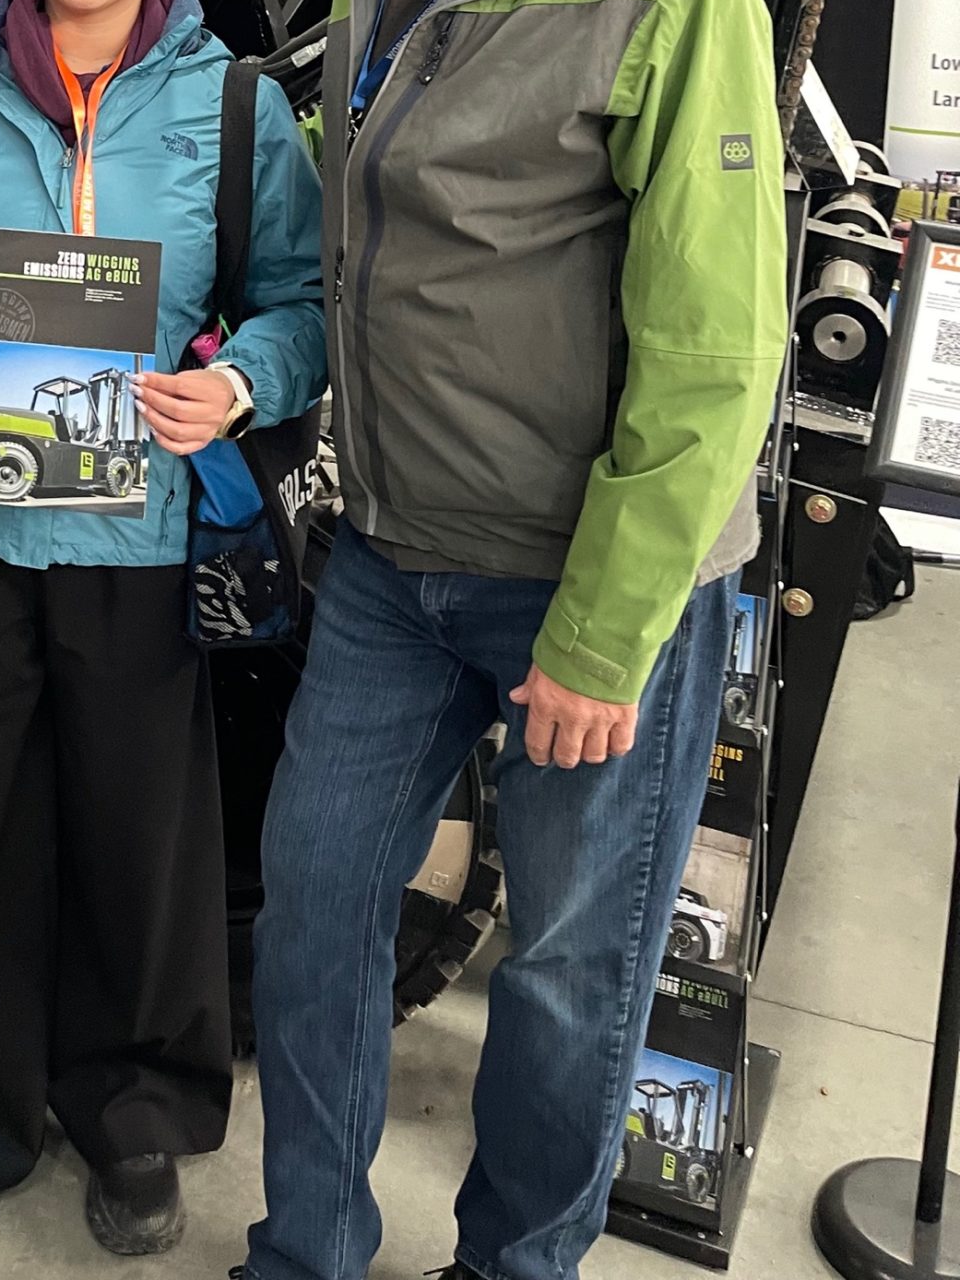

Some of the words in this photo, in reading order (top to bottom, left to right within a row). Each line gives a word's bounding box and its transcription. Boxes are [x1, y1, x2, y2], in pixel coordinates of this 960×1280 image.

[57, 250, 85, 267] ZERO
[87, 254, 140, 271] WIGGINS
[23, 261, 85, 280] EMISSIONS
[85, 267, 101, 281] AG
[105, 270, 142, 285] eBULL
